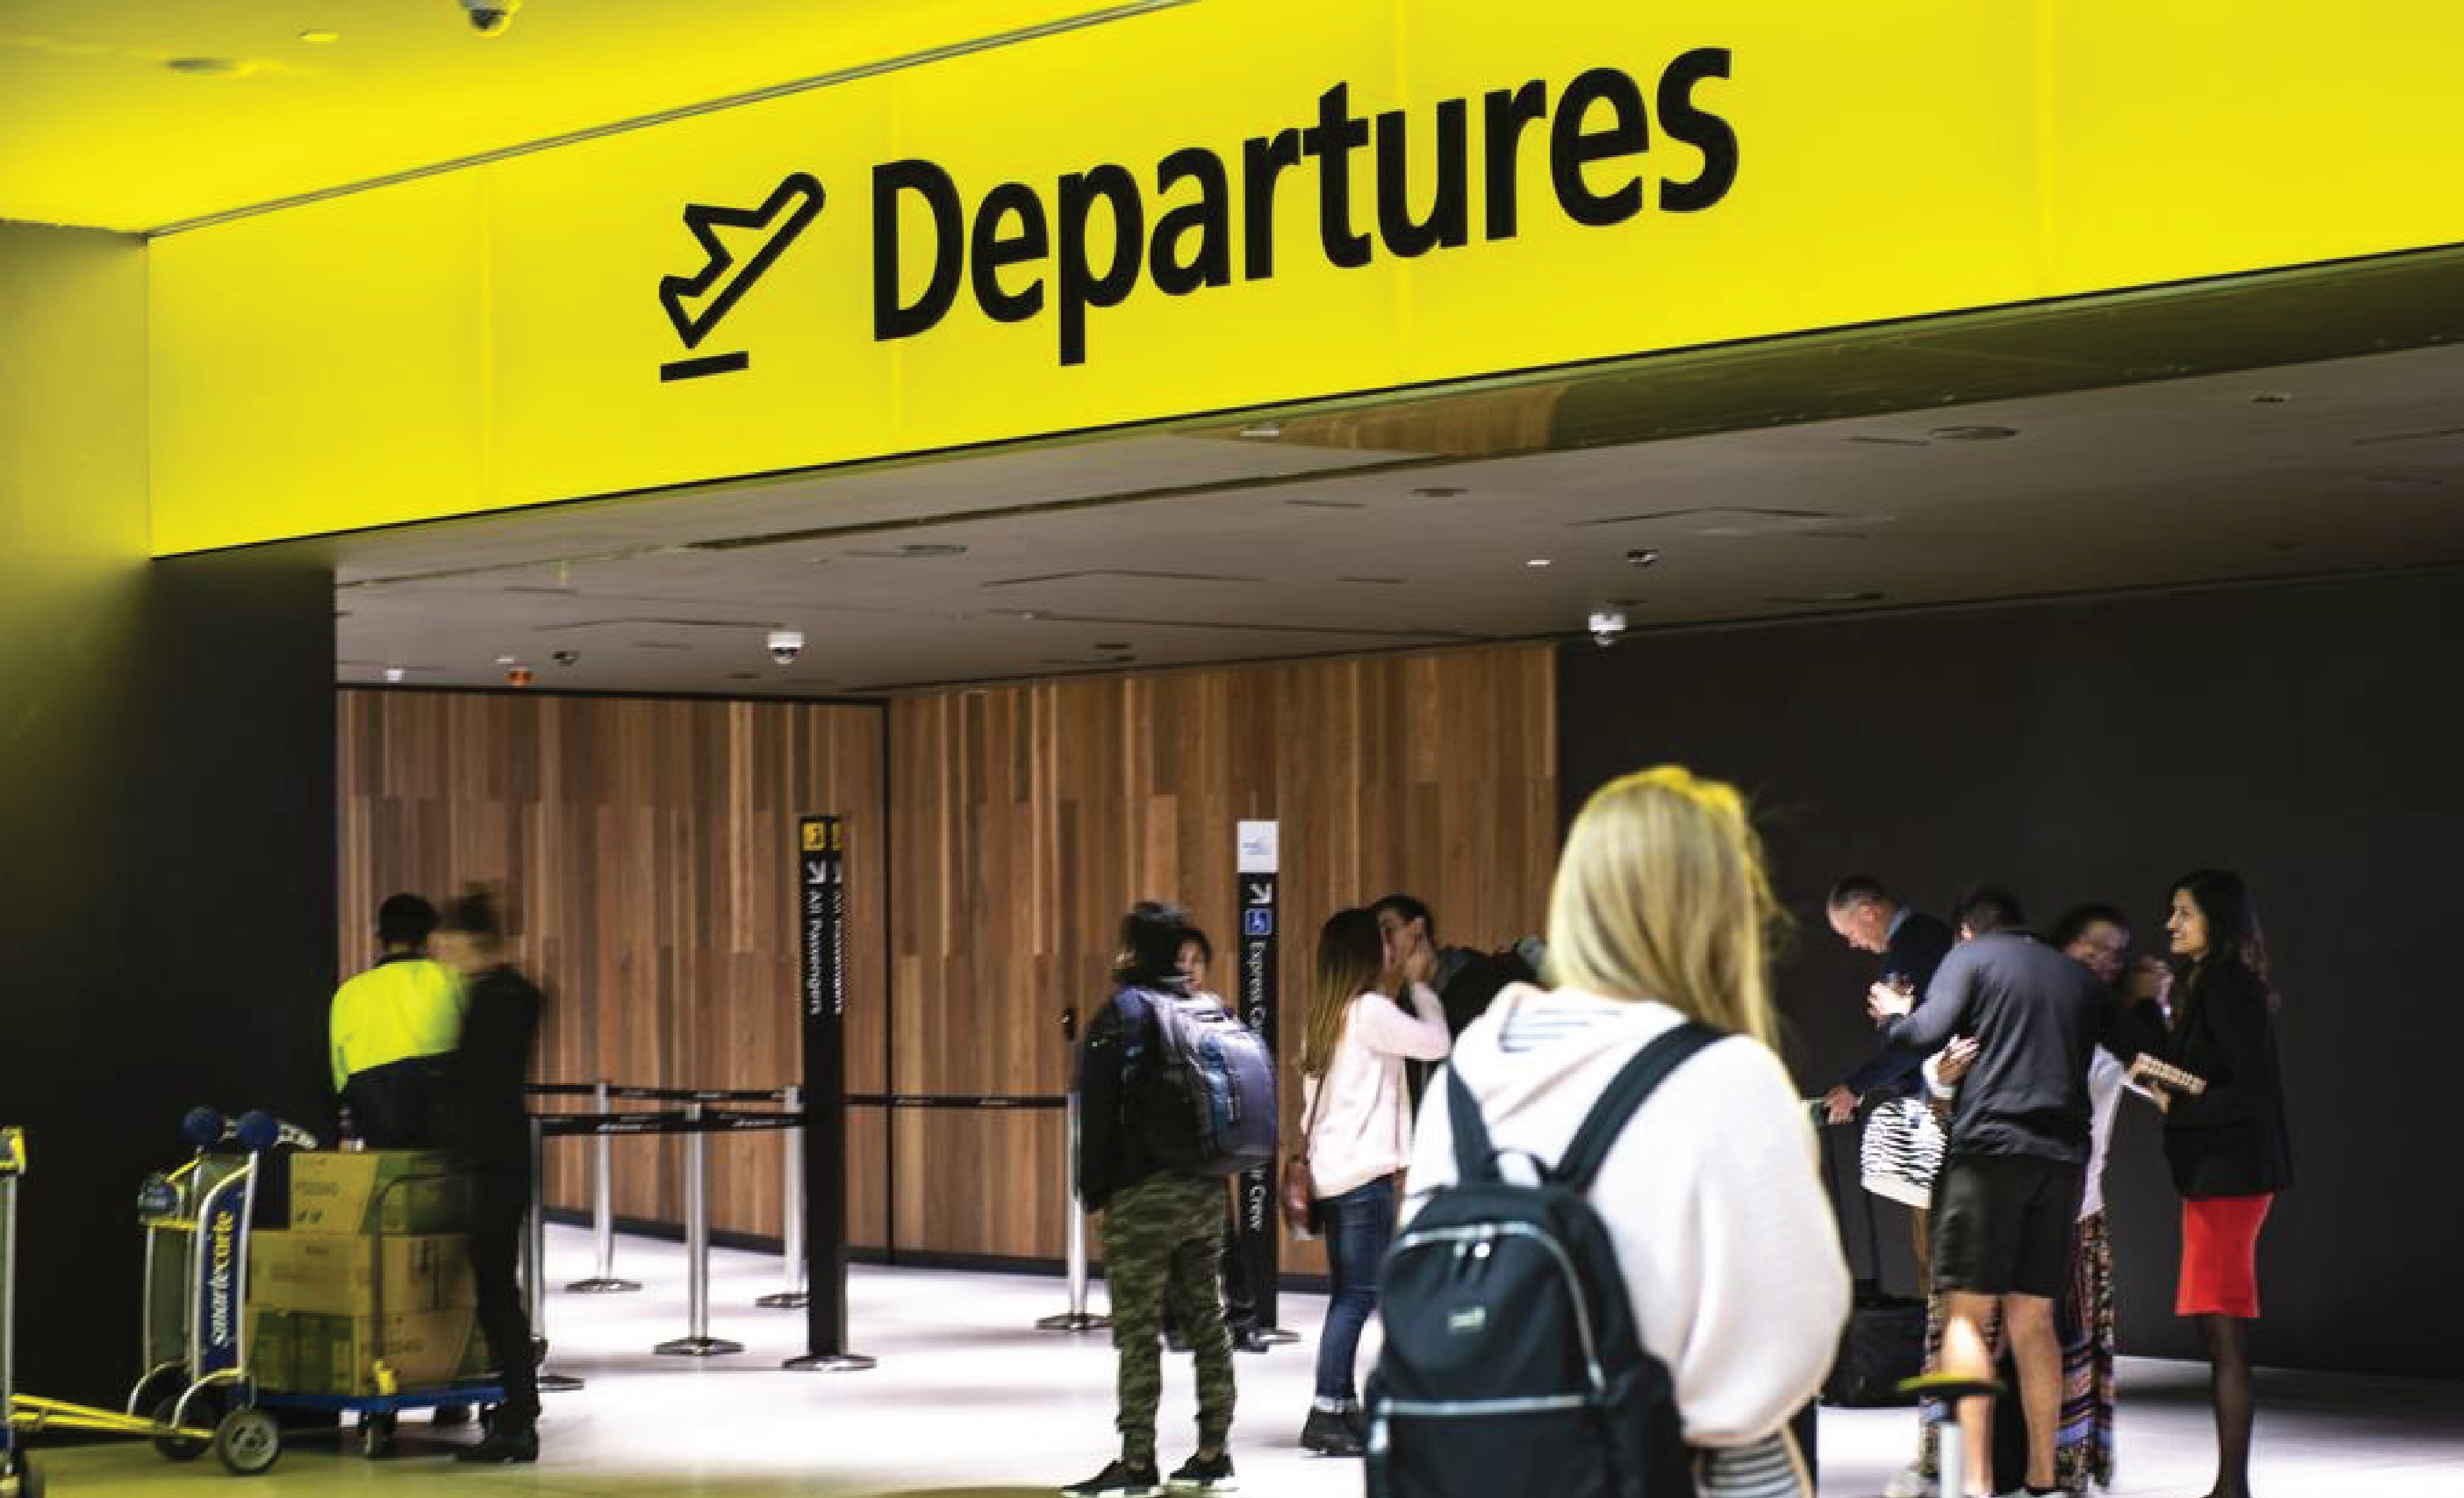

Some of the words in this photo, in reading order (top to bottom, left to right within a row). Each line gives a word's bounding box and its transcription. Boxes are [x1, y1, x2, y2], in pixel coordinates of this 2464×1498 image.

[872, 48, 1737, 366] Departures
[808, 890, 822, 914] All
[807, 919, 823, 1015] Passengers
[1247, 941, 1266, 1002] Express
[1249, 1184, 1267, 1231] Crew
